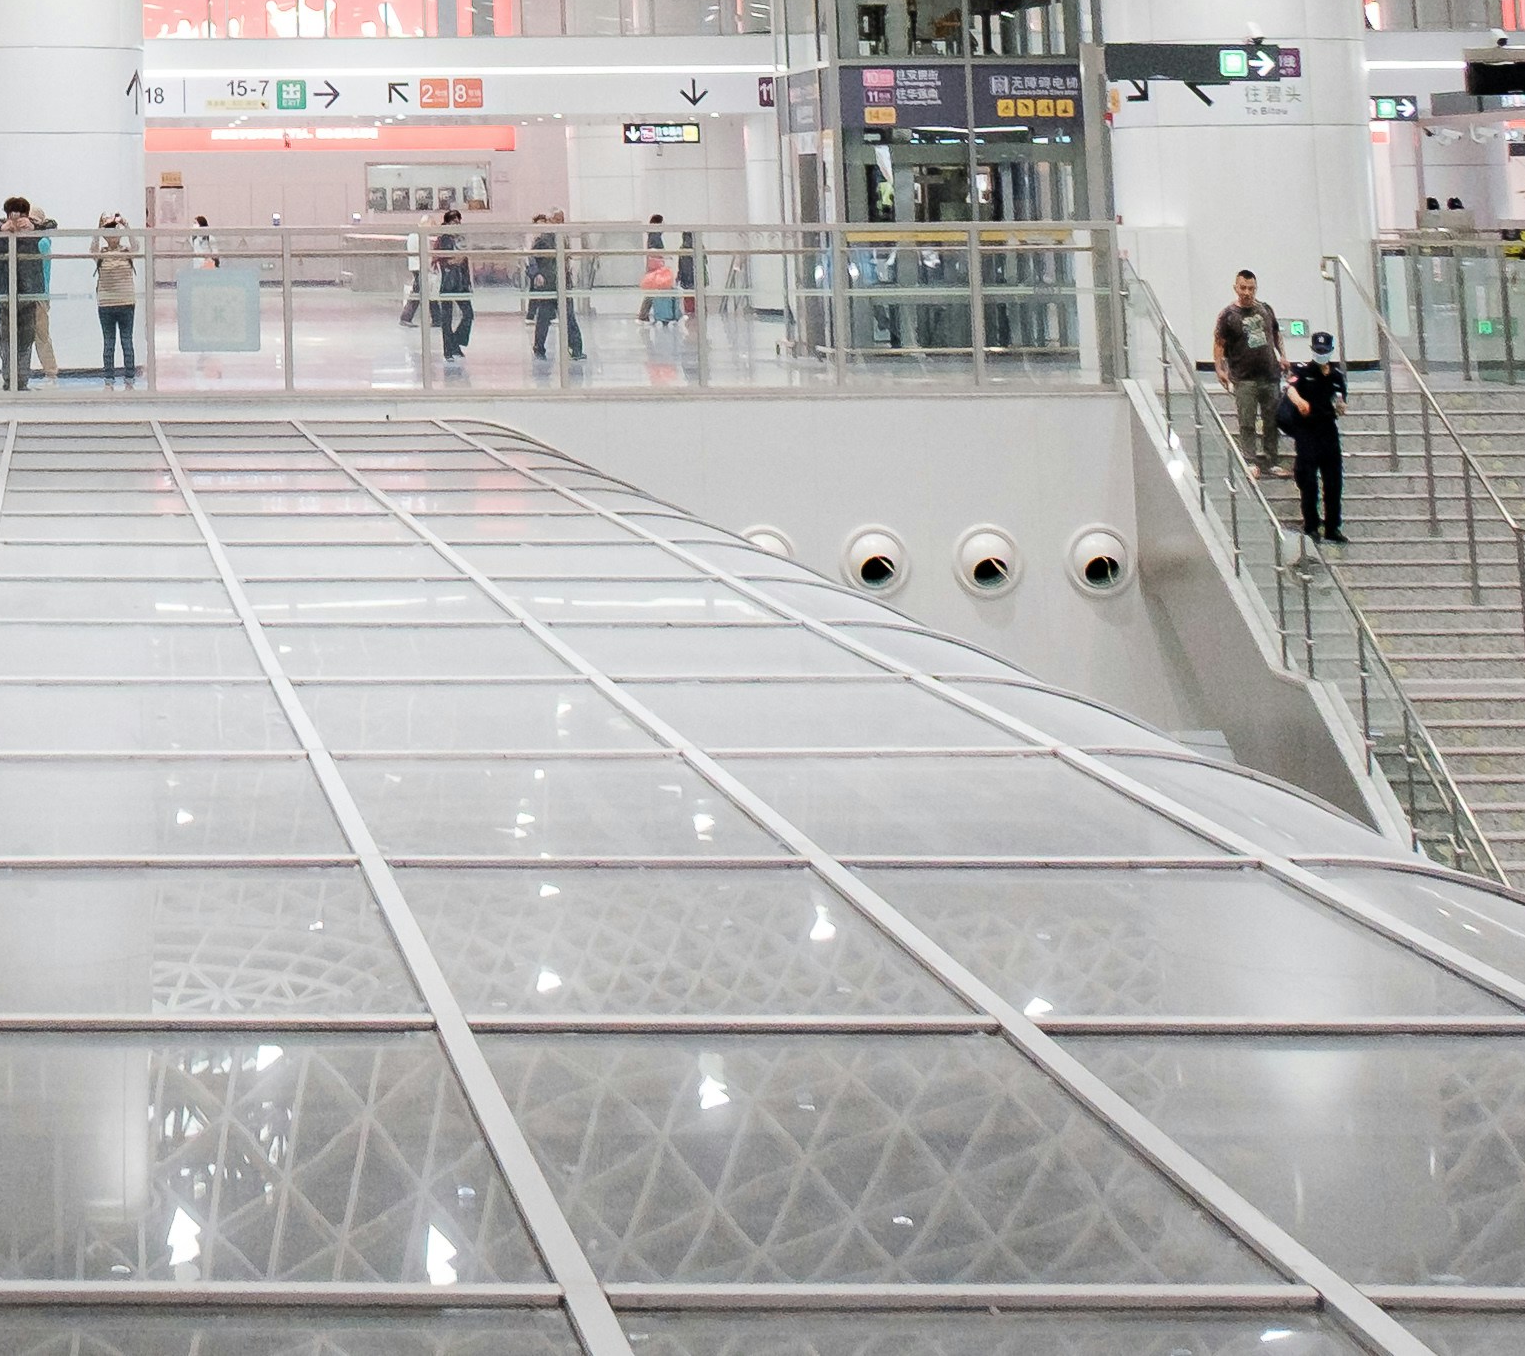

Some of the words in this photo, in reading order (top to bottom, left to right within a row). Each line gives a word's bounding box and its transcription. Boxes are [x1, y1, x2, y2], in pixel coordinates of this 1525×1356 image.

[145, 87, 165, 104] 18
[227, 80, 269, 96] 15-7
[421, 84, 434, 103] 2
[454, 84, 467, 103] 8
[1246, 86, 1302, 103] 往碧头
